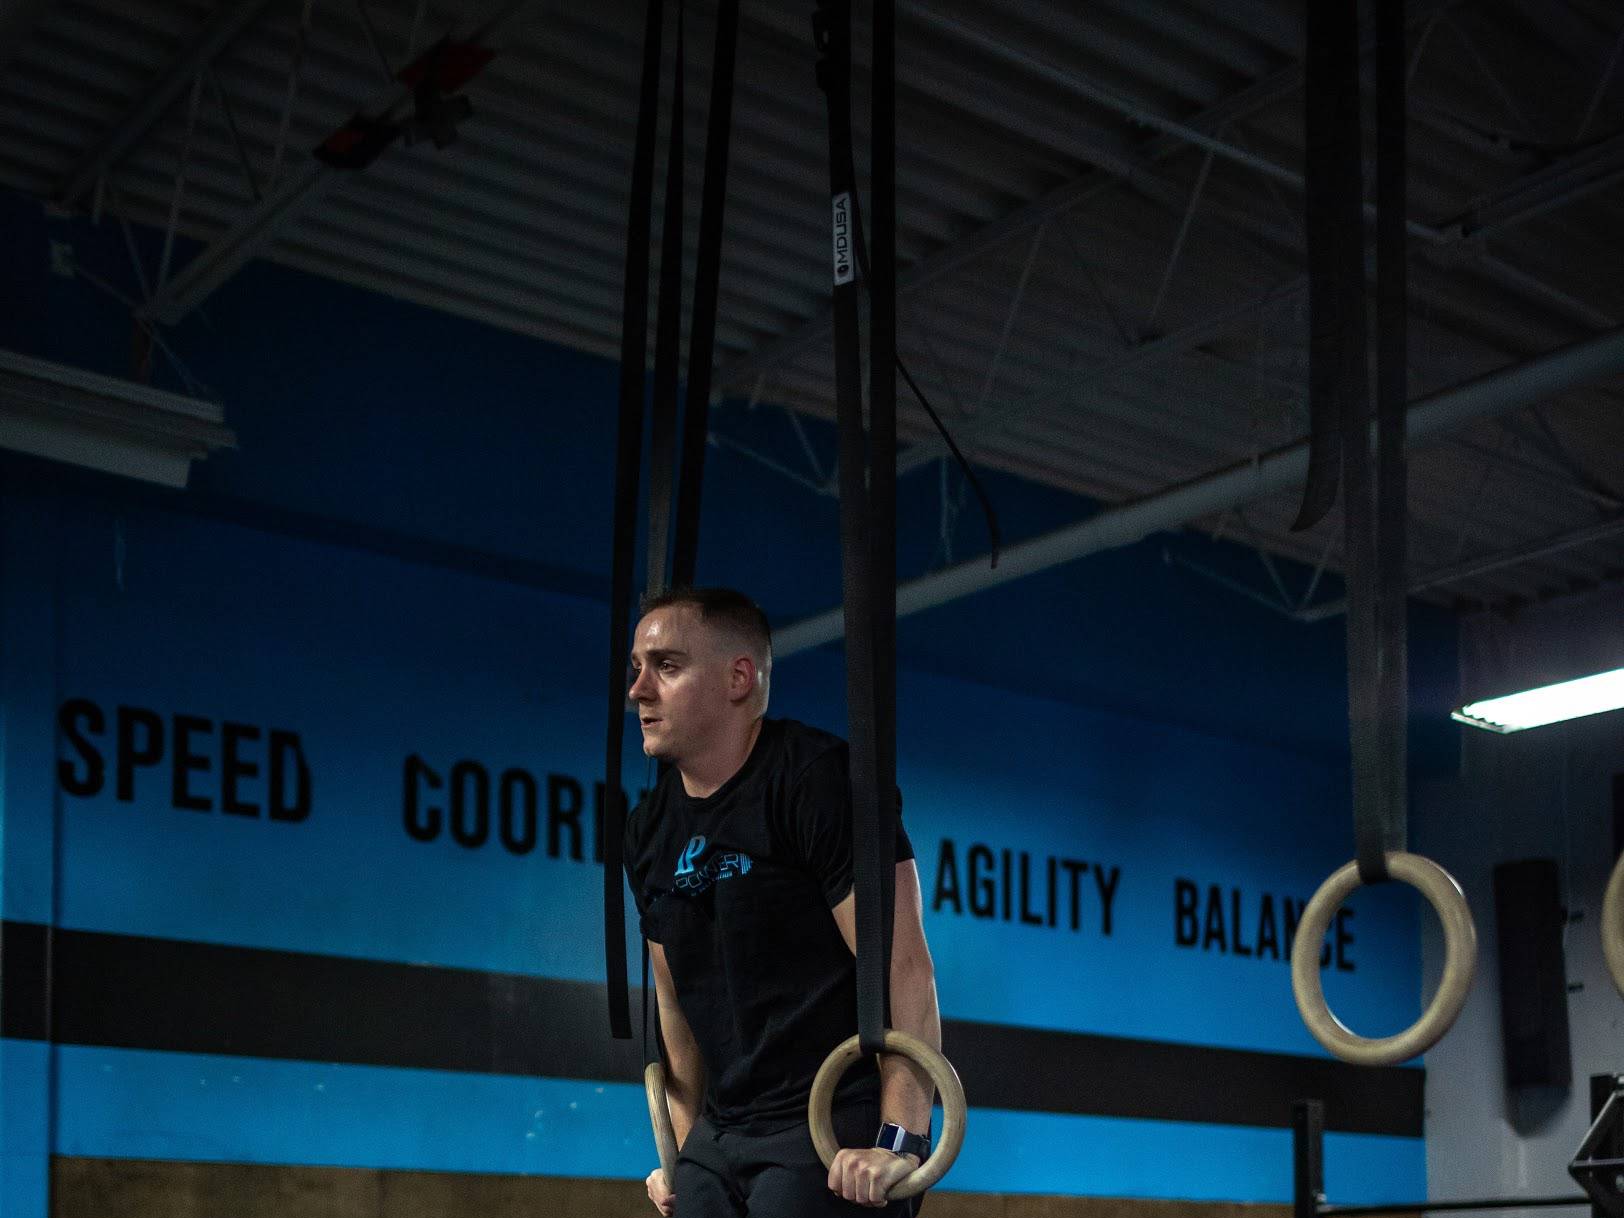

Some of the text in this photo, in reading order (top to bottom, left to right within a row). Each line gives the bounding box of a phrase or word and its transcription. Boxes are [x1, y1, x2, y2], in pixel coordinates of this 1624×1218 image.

[836, 198, 849, 264] MDUSA
[56, 698, 314, 824] SPEED
[932, 838, 1122, 937] AGILITY
